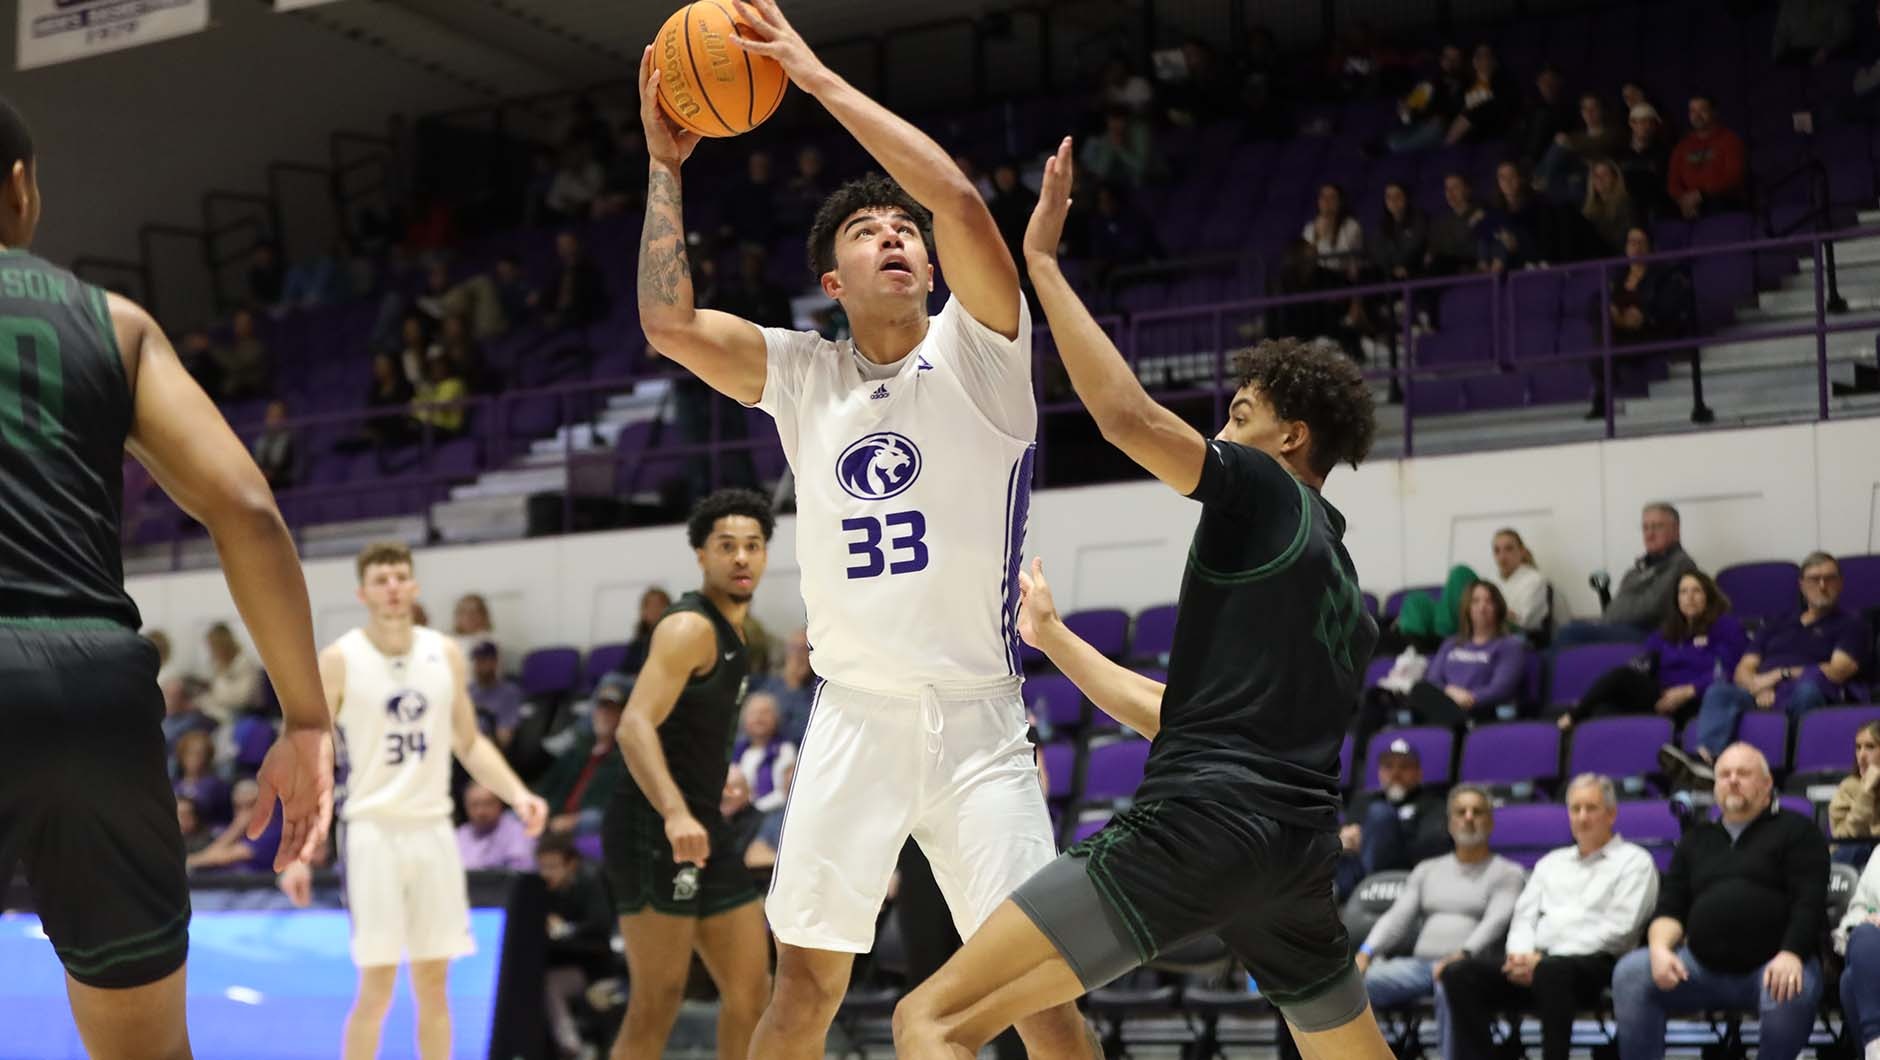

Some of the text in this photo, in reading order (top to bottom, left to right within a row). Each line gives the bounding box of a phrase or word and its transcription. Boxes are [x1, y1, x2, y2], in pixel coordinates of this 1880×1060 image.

[664, 27, 700, 118] Wilson
[841, 510, 929, 580] 33
[386, 731, 427, 766] 34
